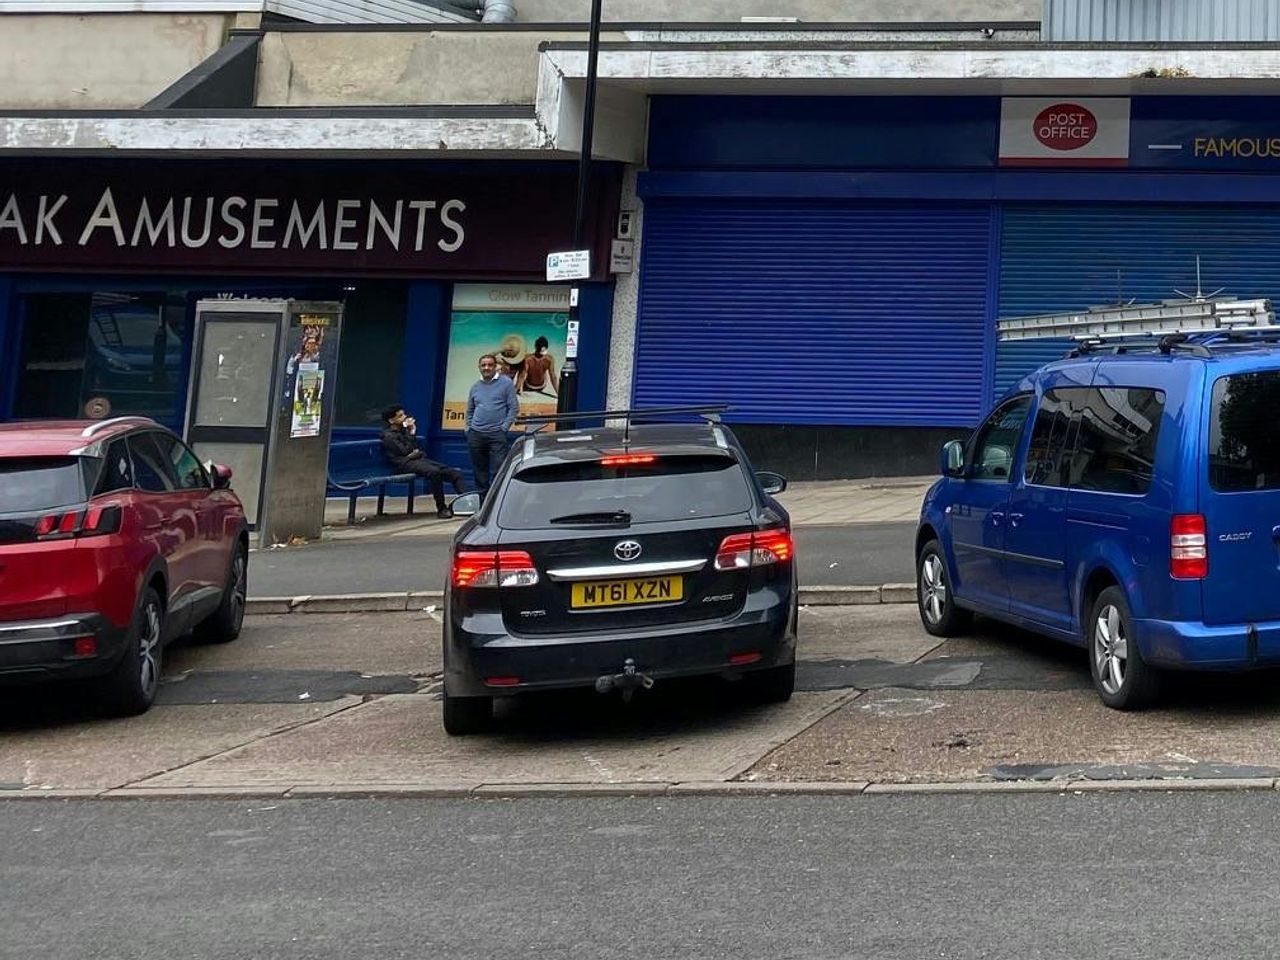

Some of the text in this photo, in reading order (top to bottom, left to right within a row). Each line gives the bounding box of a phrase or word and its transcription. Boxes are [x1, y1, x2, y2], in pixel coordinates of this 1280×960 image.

[1048, 113, 1086, 127] POST
[1039, 126, 1090, 140] OFFICE
[78, 185, 468, 254] AMUSEMENTS
[488, 289, 571, 302] Glow Tannin
[584, 580, 672, 605] MT61 XZN
